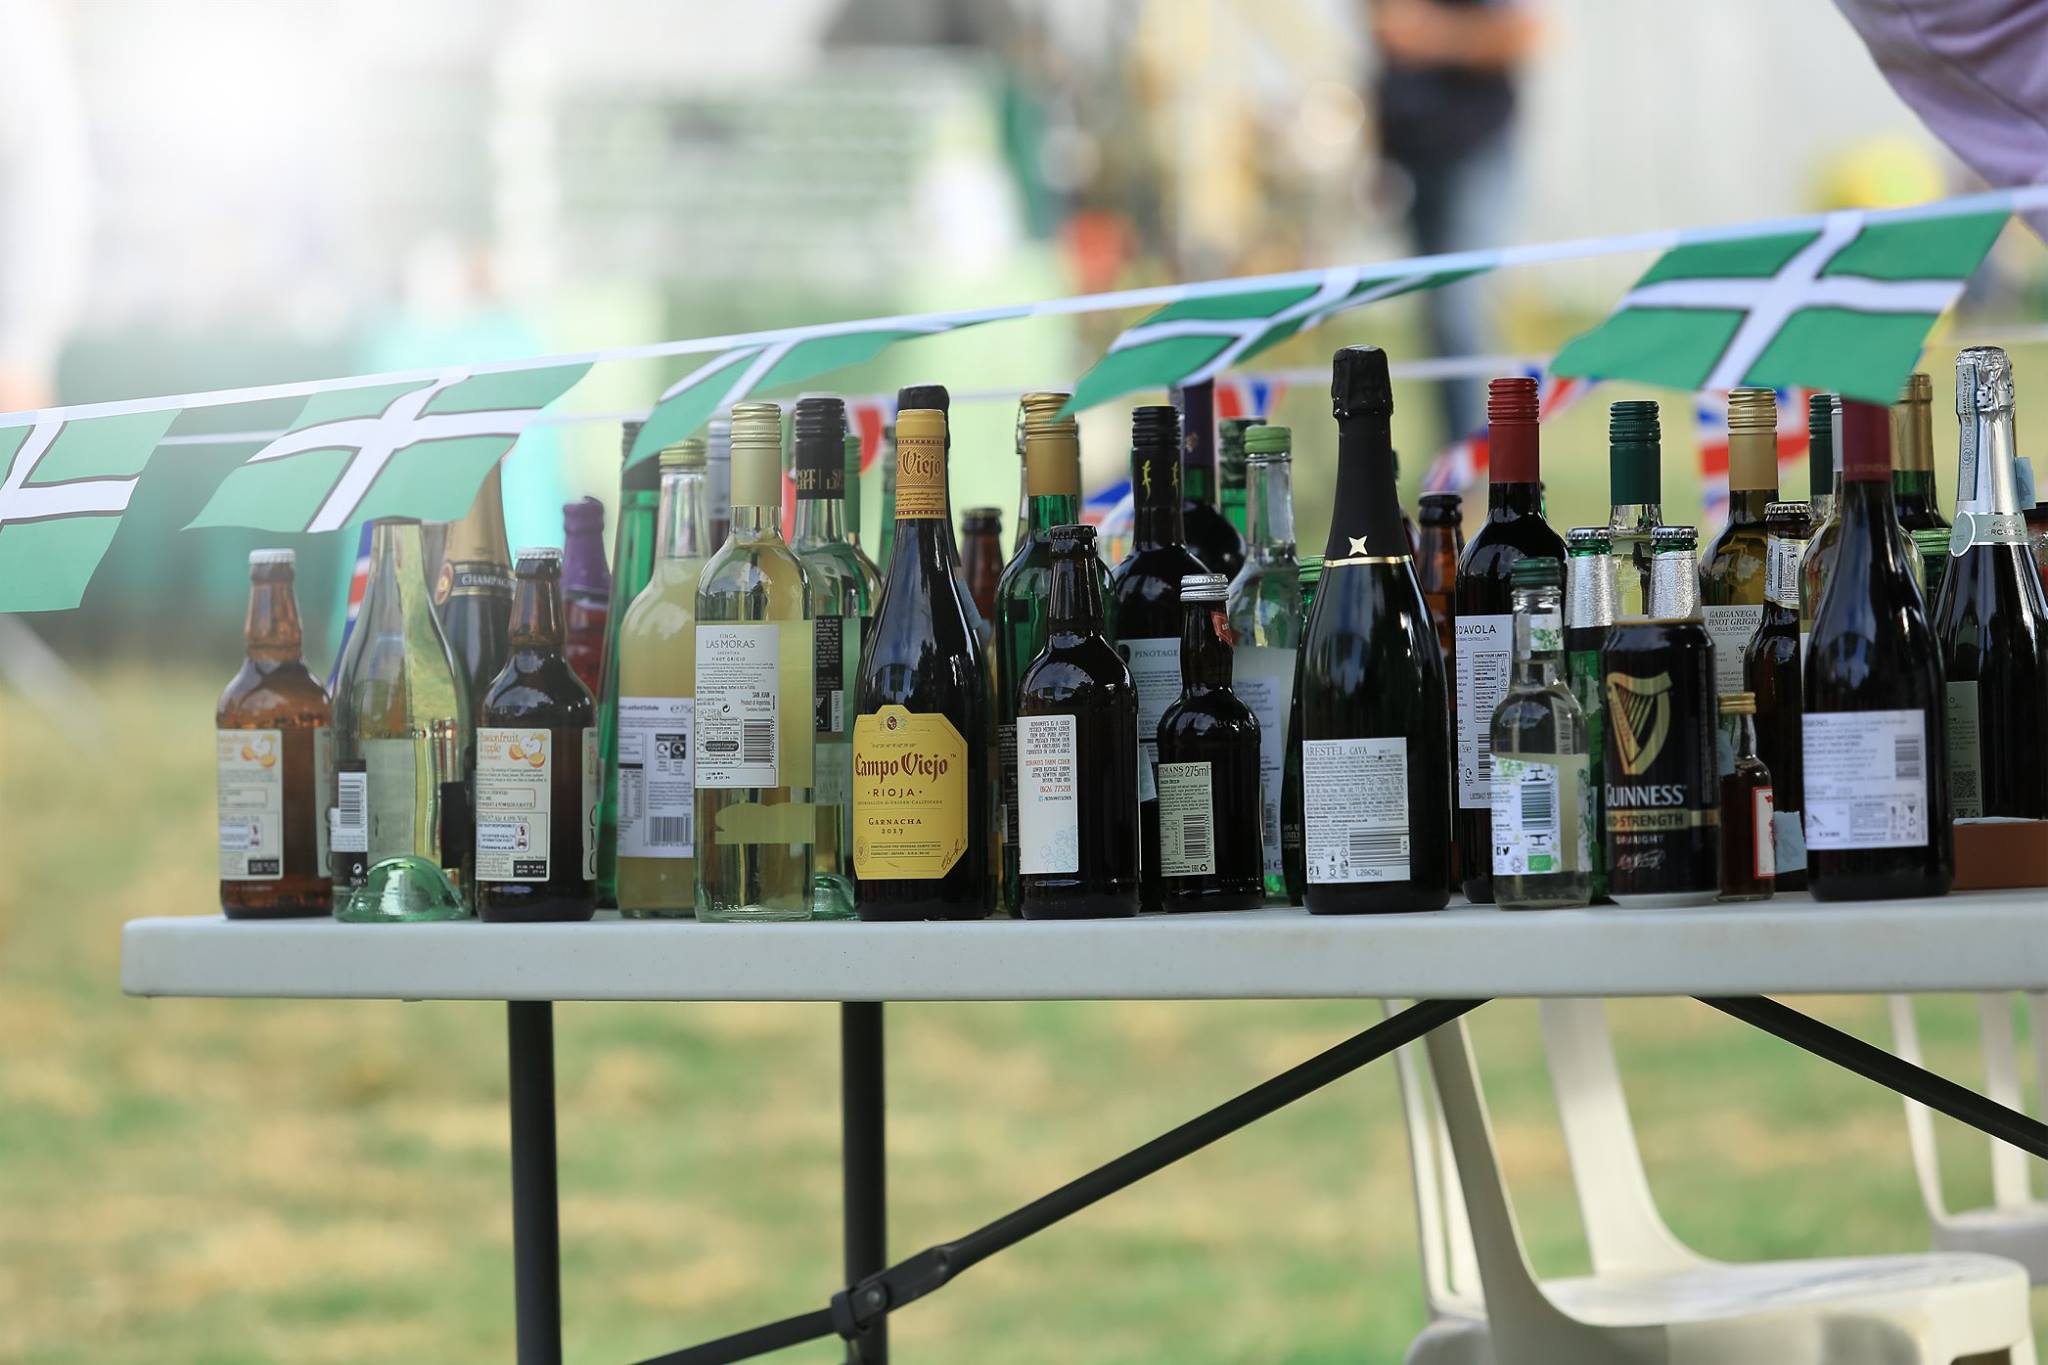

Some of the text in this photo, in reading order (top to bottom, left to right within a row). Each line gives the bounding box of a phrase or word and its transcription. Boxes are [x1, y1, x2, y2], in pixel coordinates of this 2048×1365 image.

[902, 450, 941, 480] Viejo
[1709, 610, 1757, 618] GARGANEGA
[1708, 618, 1760, 626] PINOT GRIGIO
[705, 639, 755, 649] LAS MORAS
[1135, 649, 1179, 658] PINOTAGE
[1349, 746, 1368, 755] CAVA
[855, 752, 899, 784] Campo
[901, 751, 948, 783] Viejo
[1185, 765, 1209, 777] 275ml
[873, 788, 915, 799] RIOJA
[1606, 783, 1684, 807] GUINNESS
[868, 817, 923, 826] GARNACHA
